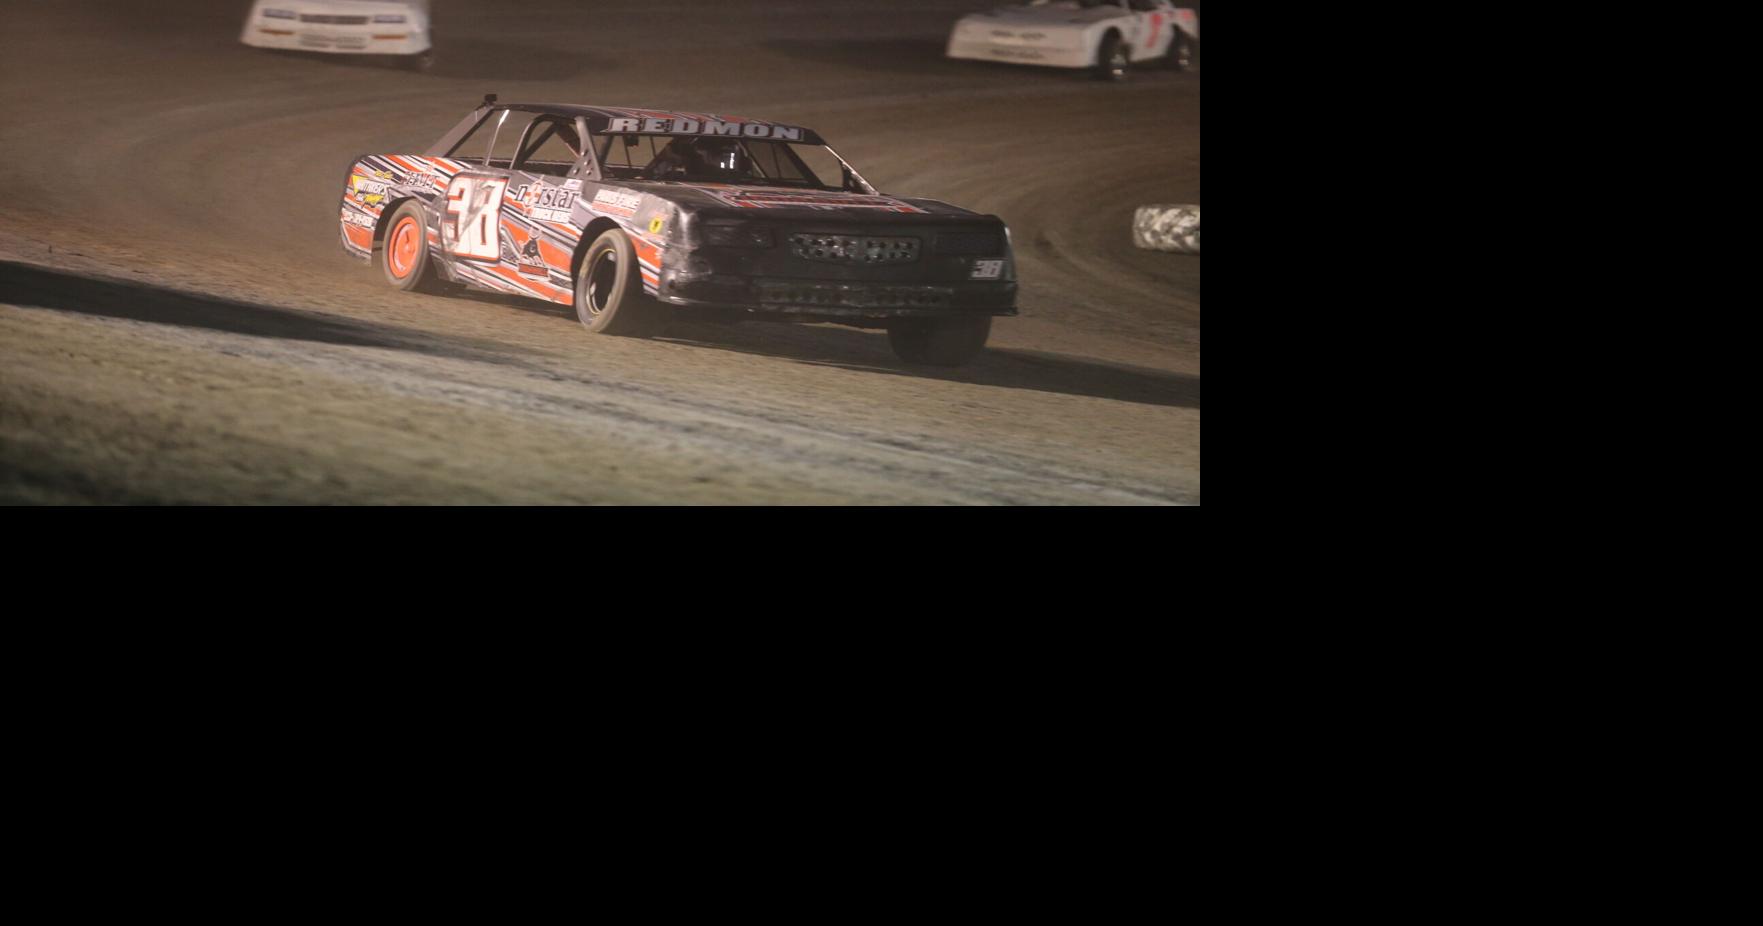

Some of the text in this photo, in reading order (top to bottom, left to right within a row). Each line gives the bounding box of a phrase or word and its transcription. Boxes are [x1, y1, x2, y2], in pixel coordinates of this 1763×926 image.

[609, 116, 800, 140] REDMON
[444, 176, 508, 260] 38
[971, 260, 1003, 278] 38
